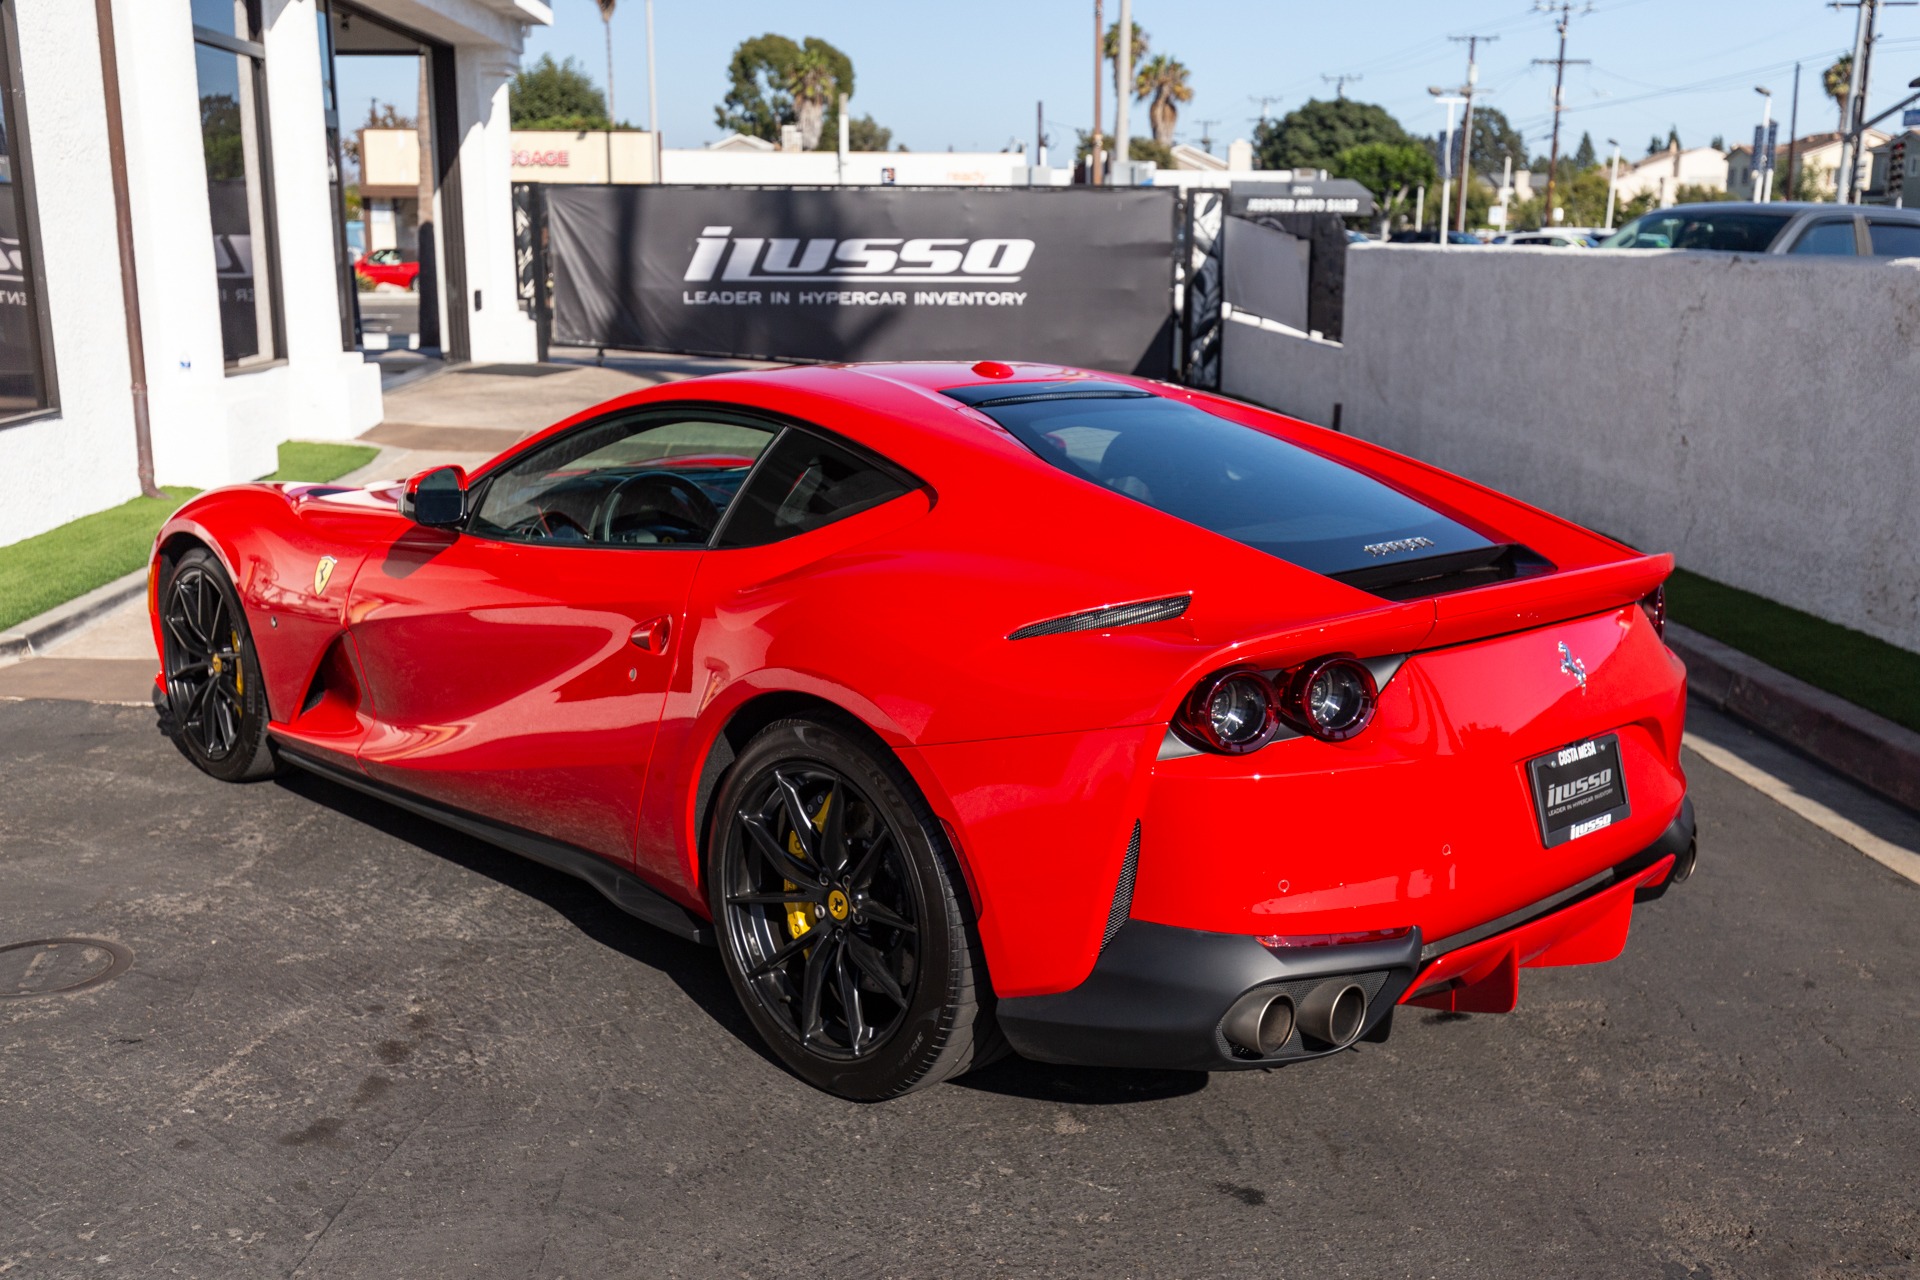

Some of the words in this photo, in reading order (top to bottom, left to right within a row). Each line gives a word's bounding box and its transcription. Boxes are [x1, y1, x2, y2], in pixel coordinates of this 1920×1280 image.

[1295, 198, 1325, 212] AUTO
[1325, 198, 1359, 212] SALES
[683, 291, 762, 305] LEADER
[770, 291, 790, 305] IN
[800, 291, 907, 305] HYPERCAR
[914, 291, 1028, 306] INVENTORY
[1557, 746, 1579, 766] COSTA
[1578, 741, 1597, 760] MESA
[1548, 806, 1566, 817] LEADER
[1573, 796, 1594, 809] HYPERCAR
[1594, 788, 1613, 799] INVENTORY
